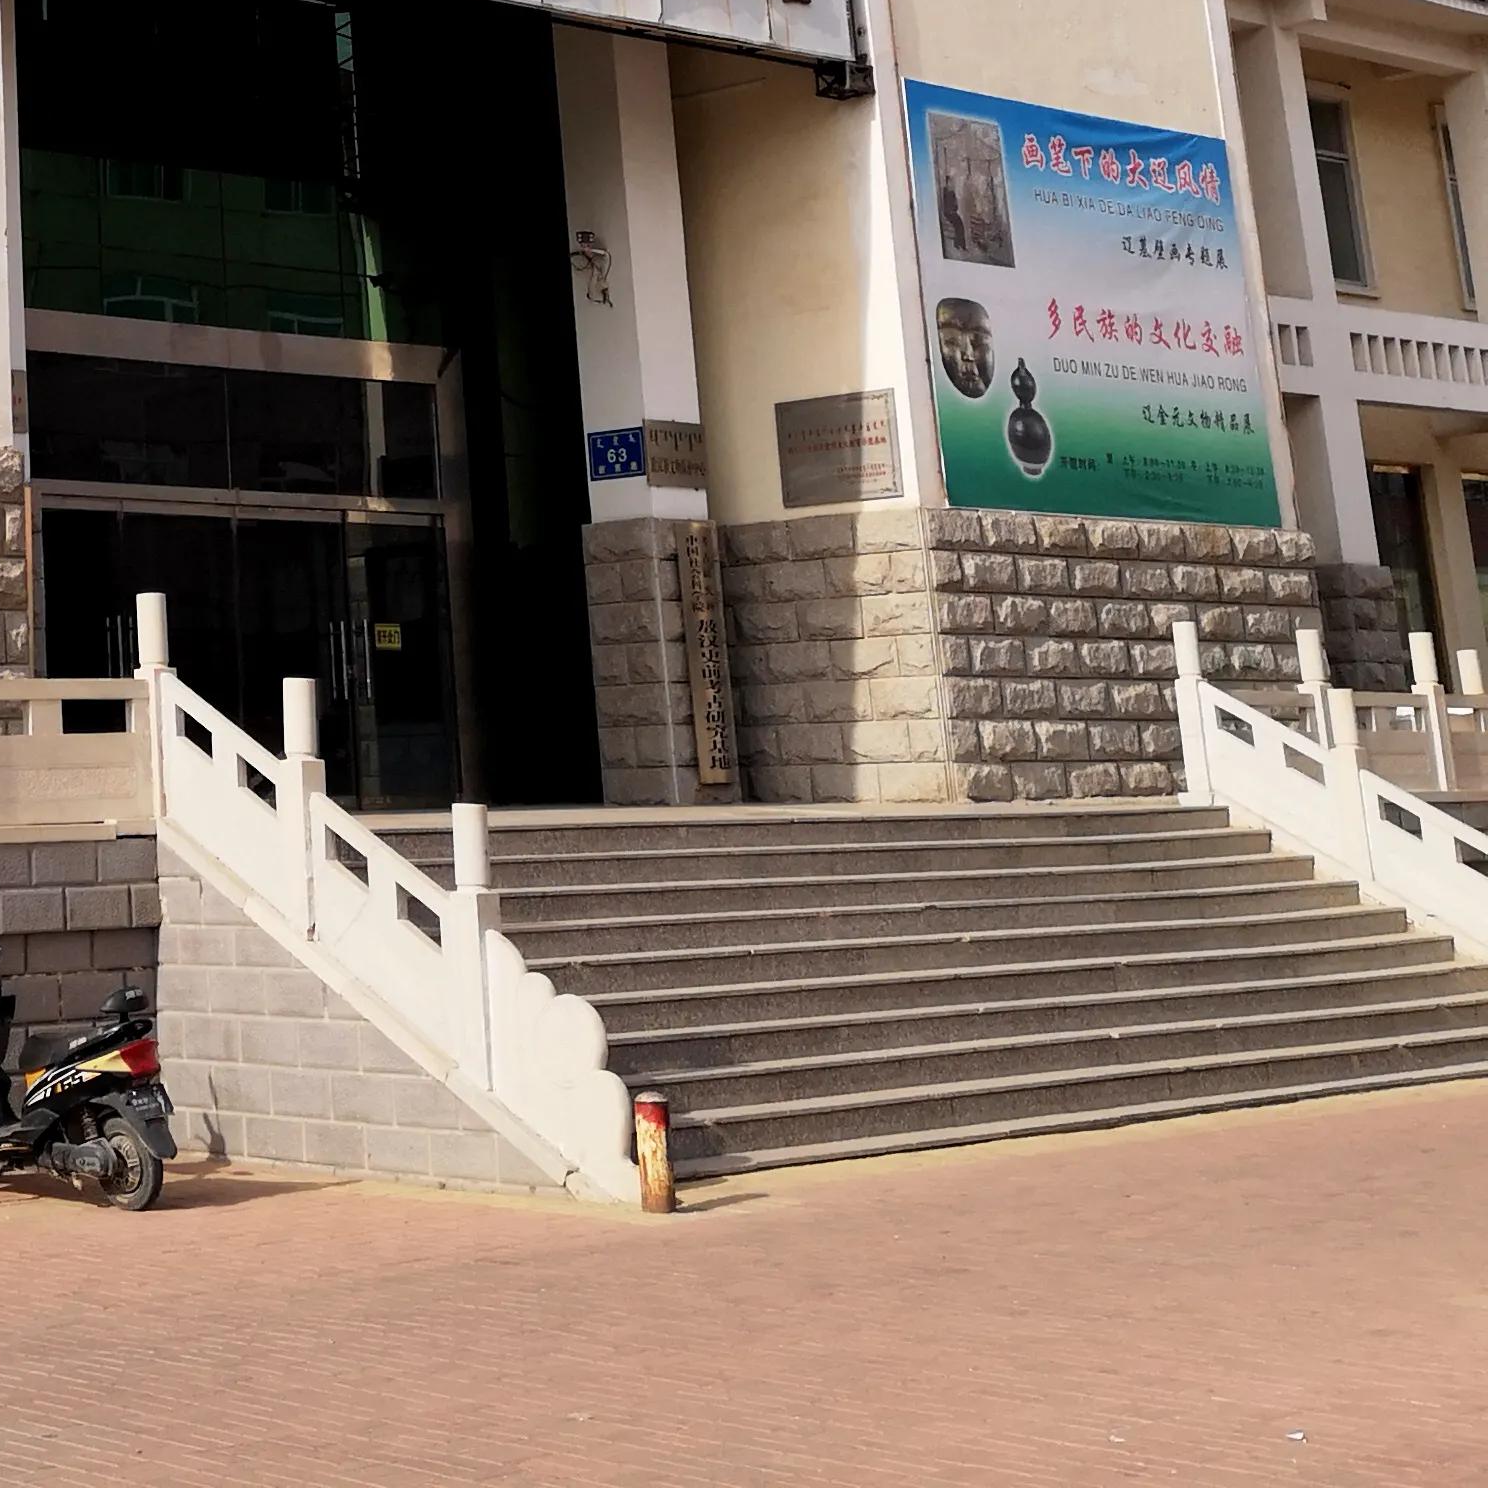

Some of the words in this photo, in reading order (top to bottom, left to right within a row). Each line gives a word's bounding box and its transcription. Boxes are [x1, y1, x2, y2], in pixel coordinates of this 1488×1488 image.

[1022, 134, 1221, 205] 画笔下的大辽风情
[1034, 189, 1059, 205] HUA
[1061, 192, 1074, 208] BI
[1076, 195, 1096, 211] XIA
[1098, 199, 1115, 215] DE
[1117, 202, 1133, 217] DA
[1136, 205, 1163, 223] LIAO
[1047, 298, 1244, 357] 多民族的文化交融
[1052, 356, 1078, 375] DUO
[1081, 360, 1102, 377] MIN
[1103, 362, 1119, 379] ZU
[1121, 364, 1137, 381] DE
[1140, 367, 1164, 384] WEN
[1166, 371, 1189, 387] HUA
[1191, 374, 1216, 390] JIAO
[1217, 375, 1248, 393] RONG
[606, 447, 629, 465] 63
